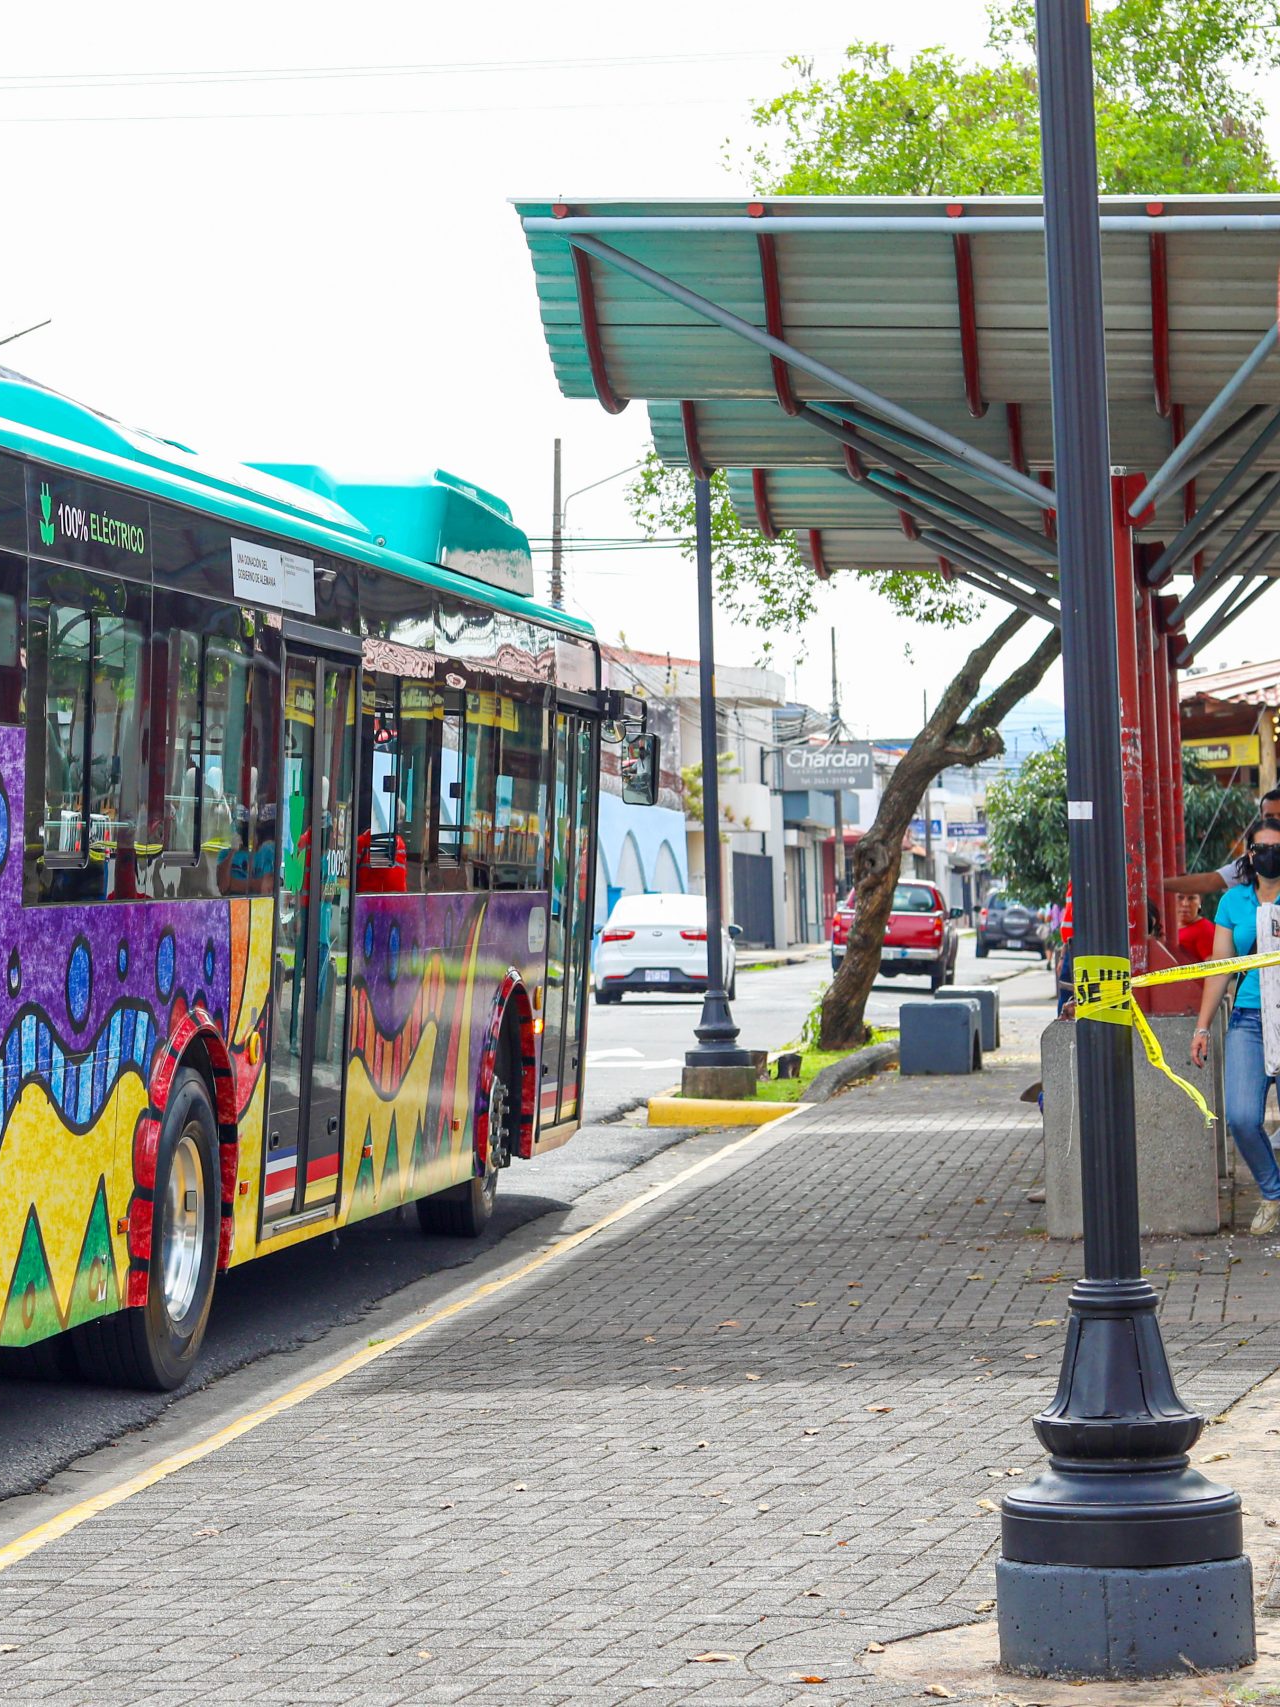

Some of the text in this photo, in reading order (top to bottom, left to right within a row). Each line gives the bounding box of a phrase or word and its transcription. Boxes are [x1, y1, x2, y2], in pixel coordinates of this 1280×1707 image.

[58, 502, 144, 554] 100% ELÉCTRICO
[786, 749, 869, 768] Chardan
[326, 848, 347, 876] 100%
